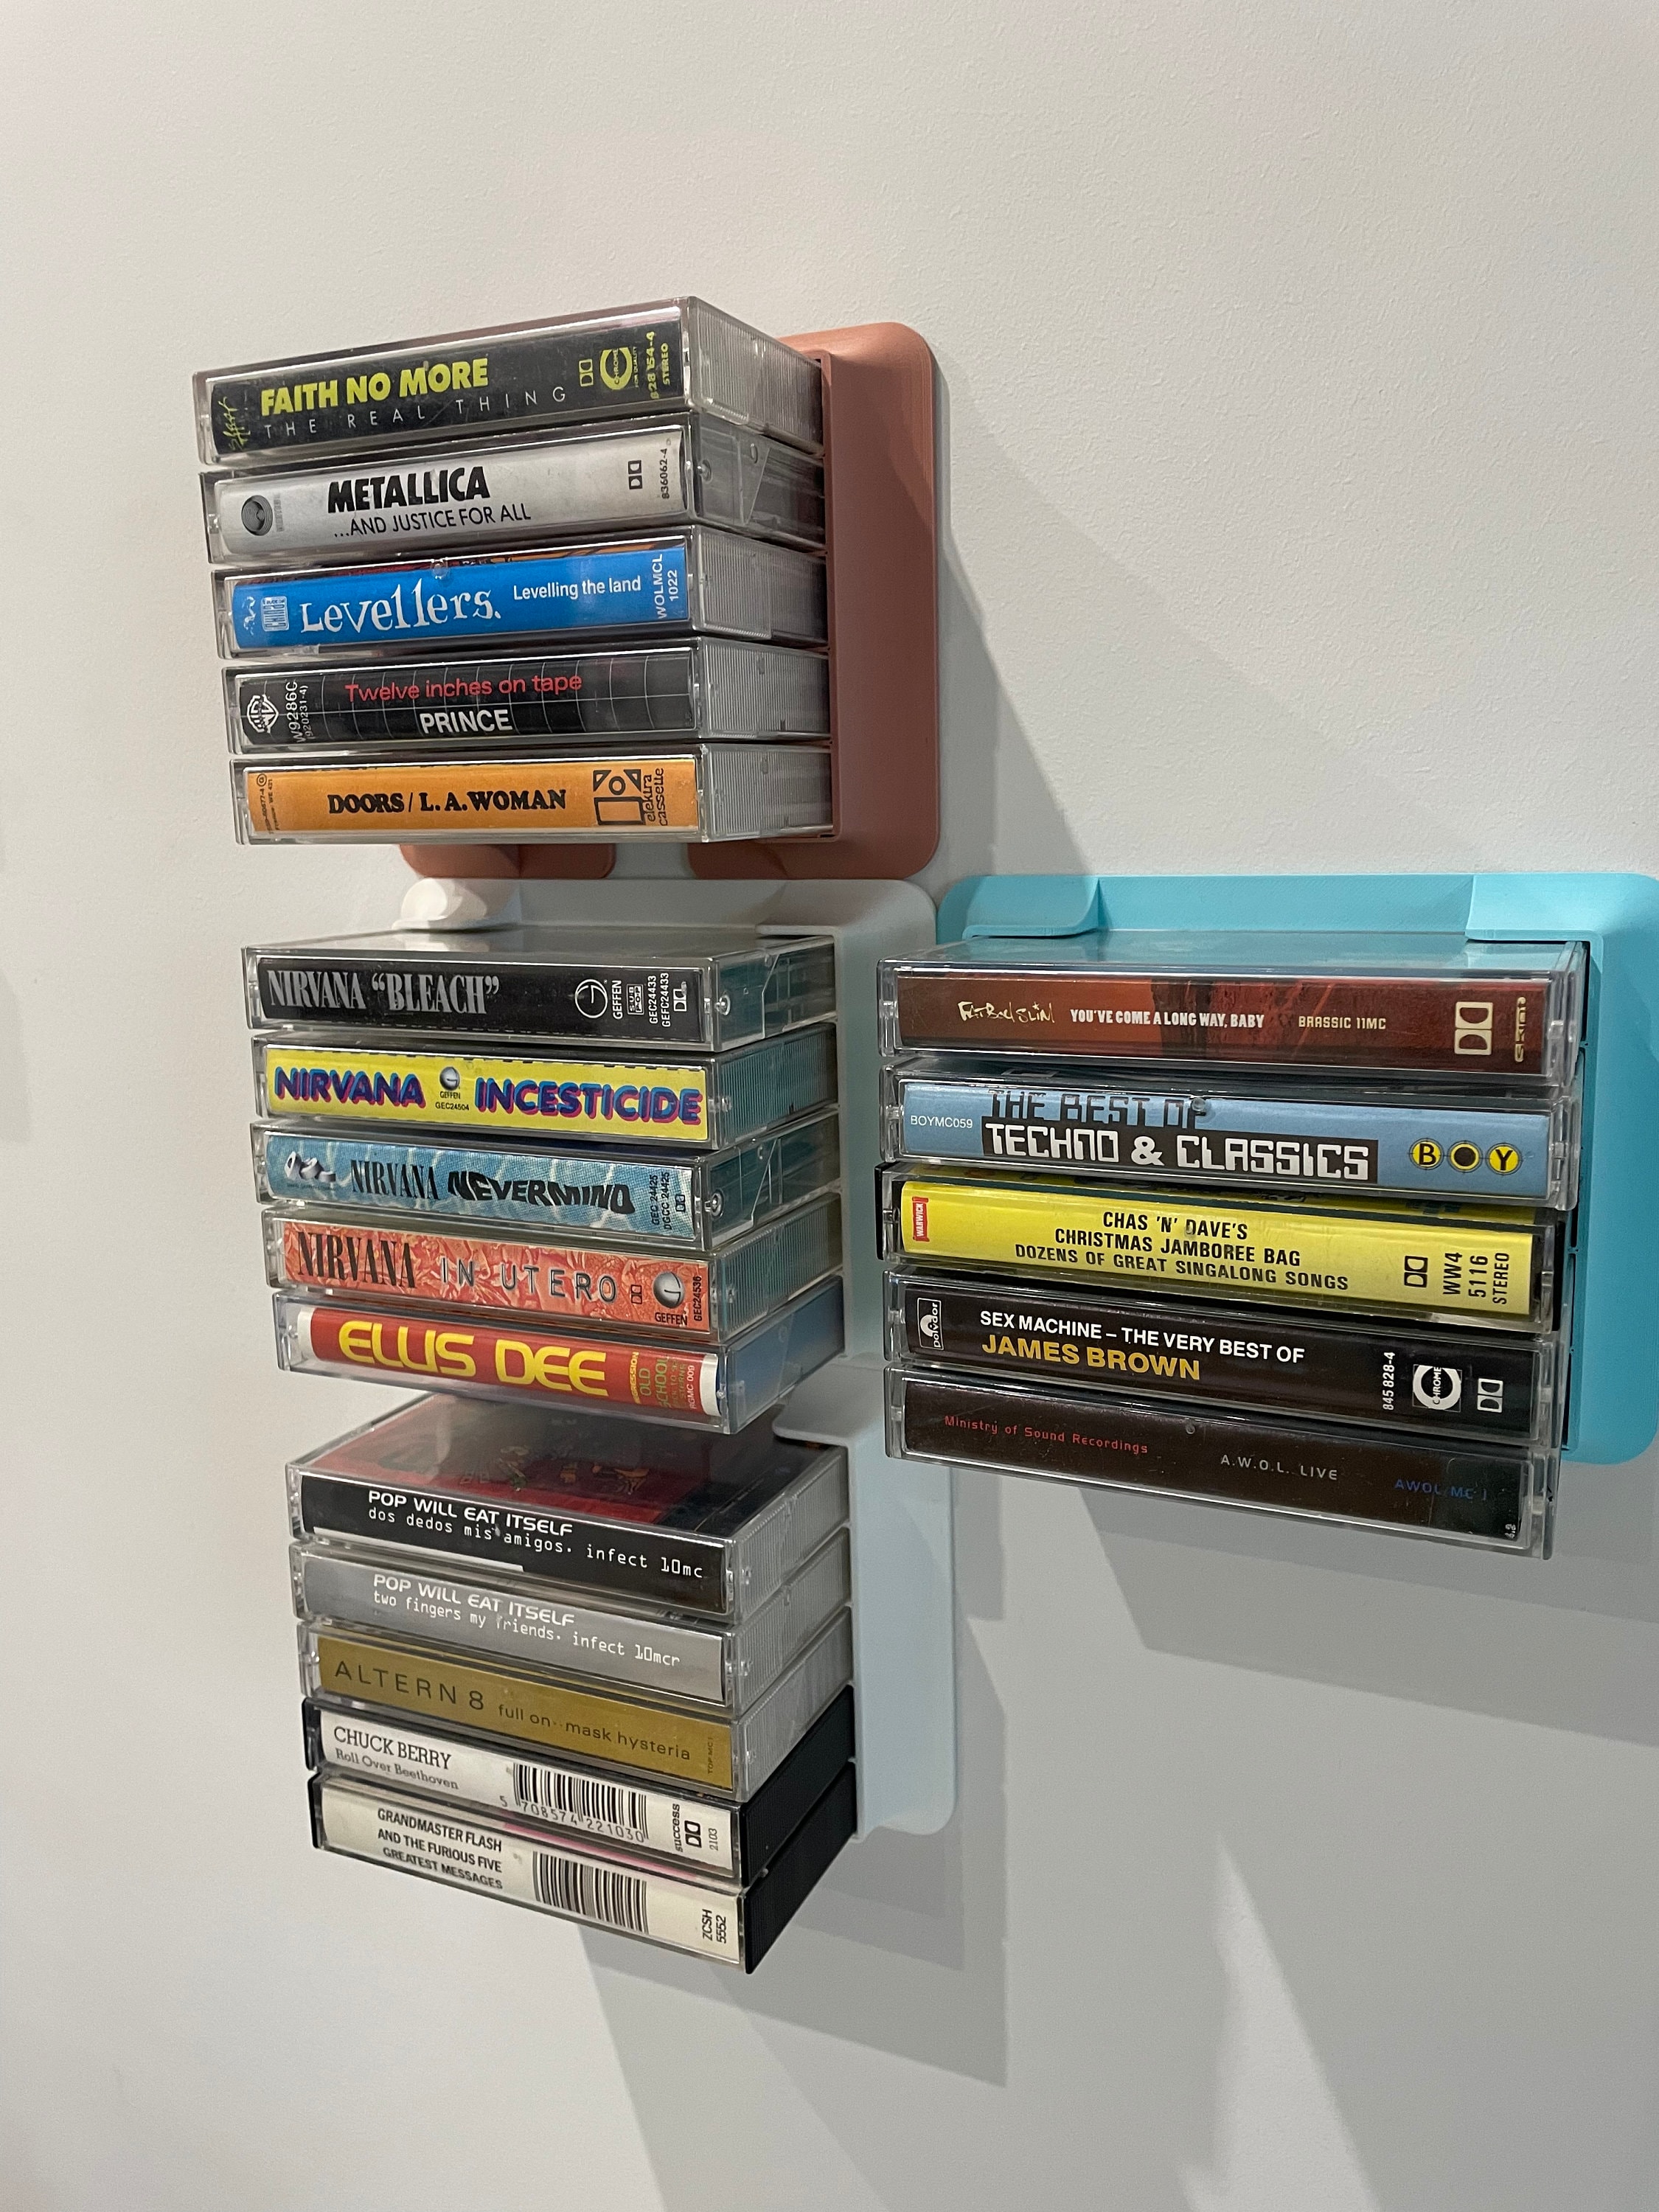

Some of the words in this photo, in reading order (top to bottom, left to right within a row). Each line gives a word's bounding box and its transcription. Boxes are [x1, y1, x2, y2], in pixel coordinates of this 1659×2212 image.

[660, 342, 670, 386] STEREO
[261, 379, 338, 417] FAITH
[346, 372, 391, 405] NO
[399, 358, 489, 398] MORE
[264, 418, 317, 439] THE
[347, 405, 425, 429] REAL
[455, 386, 566, 414] THING
[328, 466, 490, 514] METALLICA
[659, 448, 670, 500] 836062-4
[392, 509, 456, 532] JUSTICE
[458, 506, 496, 526] FOR
[500, 503, 532, 522] ALL
[513, 582, 578, 601] Levelling
[582, 579, 605, 596] the
[609, 575, 641, 594] land
[652, 553, 667, 619] WOLMCL
[667, 569, 679, 602] 1022
[344, 682, 420, 703] Twelve
[425, 678, 493, 698] inches
[498, 678, 526, 695] on
[533, 674, 582, 697] tape
[285, 681, 307, 743] W9286C
[420, 709, 513, 734] PRINCE
[327, 793, 405, 814] DOORS
[467, 789, 566, 811] WOMAN
[641, 774, 656, 823] elektra
[654, 768, 668, 827] cassette
[267, 969, 366, 1009] NIRVANA
[611, 980, 623, 1020] GEFFEN
[647, 975, 658, 1024] GEC24433
[660, 972, 671, 1028] GEFC24433
[1070, 1008, 1113, 1024] YOU'VE
[1115, 1010, 1152, 1024] COME
[1152, 1011, 1162, 1024] A
[1164, 1011, 1197, 1026] LONG
[1198, 1012, 1228, 1029] WAY,
[1230, 1013, 1265, 1029] BABY
[1298, 1015, 1352, 1029] BRASSIC
[275, 1066, 426, 1109] NIRVANA
[435, 1102, 470, 1111] GEC24504
[439, 1091, 461, 1099] GEFFEN
[475, 1077, 703, 1125] INCESTICIDE
[989, 1089, 1046, 1120] THE
[1060, 1093, 1150, 1124] BEST
[909, 1115, 974, 1130] BOYMC059
[985, 1122, 1120, 1163] TECHNO
[1130, 1135, 1166, 1166] &
[1175, 1135, 1369, 1181] CLASSICS
[350, 1159, 439, 1200] NIRVANA
[448, 1170, 636, 1214] NEVERMIND
[649, 1174, 659, 1201] 24425
[661, 1171, 671, 1201] 24425
[650, 1203, 661, 1225] GEC
[916, 1203, 925, 1237] WARWICK
[1103, 1211, 1149, 1231] CHAS
[1186, 1219, 1248, 1240] DAVE'S
[297, 1231, 417, 1289] NIRVANA
[441, 1256, 476, 1287] IN
[501, 1262, 618, 1304] UTERO
[1015, 1243, 1079, 1265] DOZENS
[1085, 1251, 1106, 1266] OF
[1113, 1253, 1168, 1273] GREAT
[1175, 1259, 1277, 1284] SINGALONG
[1285, 1270, 1349, 1291] SONGS
[1055, 1227, 1153, 1253] CHRISTMAS
[1161, 1238, 1256, 1264] JAMBOREE
[1264, 1248, 1301, 1267] BAG
[1442, 1251, 1463, 1295] WW4
[1492, 1252, 1510, 1305] STEREO
[654, 1312, 689, 1326] GEFFEN
[692, 1275, 703, 1322] GEC24536
[932, 1302, 940, 1349] polydor
[980, 1310, 1015, 1329] SEX
[1018, 1314, 1102, 1340] MACHINE
[1121, 1326, 1160, 1347] THE
[1163, 1332, 1216, 1353] VERY
[1220, 1338, 1273, 1360] BEST
[1276, 1346, 1306, 1363] OF
[495, 1338, 610, 1397] DEE
[686, 1364, 695, 1382] 009
[981, 1334, 1080, 1364] JAMES
[1086, 1346, 1201, 1381] BROWN
[1382, 1351, 1396, 1388] 828-4
[638, 1367, 652, 1397] OLD
[653, 1355, 671, 1409] SCHOOL
[1382, 1388, 1394, 1411] 845
[1432, 1366, 1441, 1405] CHROME
[1004, 1425, 1018, 1436] of
[1024, 1426, 1065, 1443] Sound
[1072, 1433, 1149, 1455] Recordings
[1300, 1464, 1338, 1481] LIVE
[1394, 1478, 1441, 1495] AWOL
[369, 1489, 408, 1508] POP
[414, 1497, 458, 1519] WILL
[464, 1506, 501, 1525] EAT
[506, 1513, 573, 1537] ITSELF
[369, 1506, 396, 1523] dos
[406, 1512, 453, 1534] dedos
[587, 1543, 647, 1568] infect
[661, 1557, 703, 1579] 10mc
[373, 1573, 411, 1593] POP
[417, 1582, 462, 1605] WILL
[467, 1593, 504, 1613] EAT
[509, 1600, 575, 1627] ITSELF
[374, 1590, 397, 1607] two
[405, 1596, 462, 1621] fingers
[470, 1612, 487, 1629] my
[572, 1630, 625, 1656] infect
[634, 1644, 681, 1667] 10mcr
[335, 1660, 456, 1705] ALTERN
[469, 1689, 484, 1711] 8
[498, 1703, 524, 1721] full
[565, 1722, 612, 1742] mask
[617, 1731, 691, 1761] hysteria
[334, 1725, 394, 1756] CHUCK
[397, 1741, 453, 1770] BERRY
[335, 1747, 359, 1764] Roll
[361, 1755, 392, 1773] Over
[394, 1762, 459, 1790] Beethoven
[378, 1807, 464, 1843] GRANDMASTER
[465, 1832, 502, 1853] FLASH
[499, 1795, 508, 1807] 5
[521, 1800, 579, 1827] 708574
[585, 1818, 645, 1843] 221030
[672, 1803, 684, 1852] success
[378, 1827, 401, 1845] AND
[403, 1834, 426, 1852] THE
[428, 1840, 476, 1867] FURIOUS
[478, 1854, 503, 1874] FIVE
[709, 1828, 718, 1852] 2103
[383, 1846, 439, 1872] GREATEST
[441, 1863, 504, 1890] MESSAGES
[701, 1908, 713, 1941] ZCSH
[716, 1914, 727, 1944] 5552
